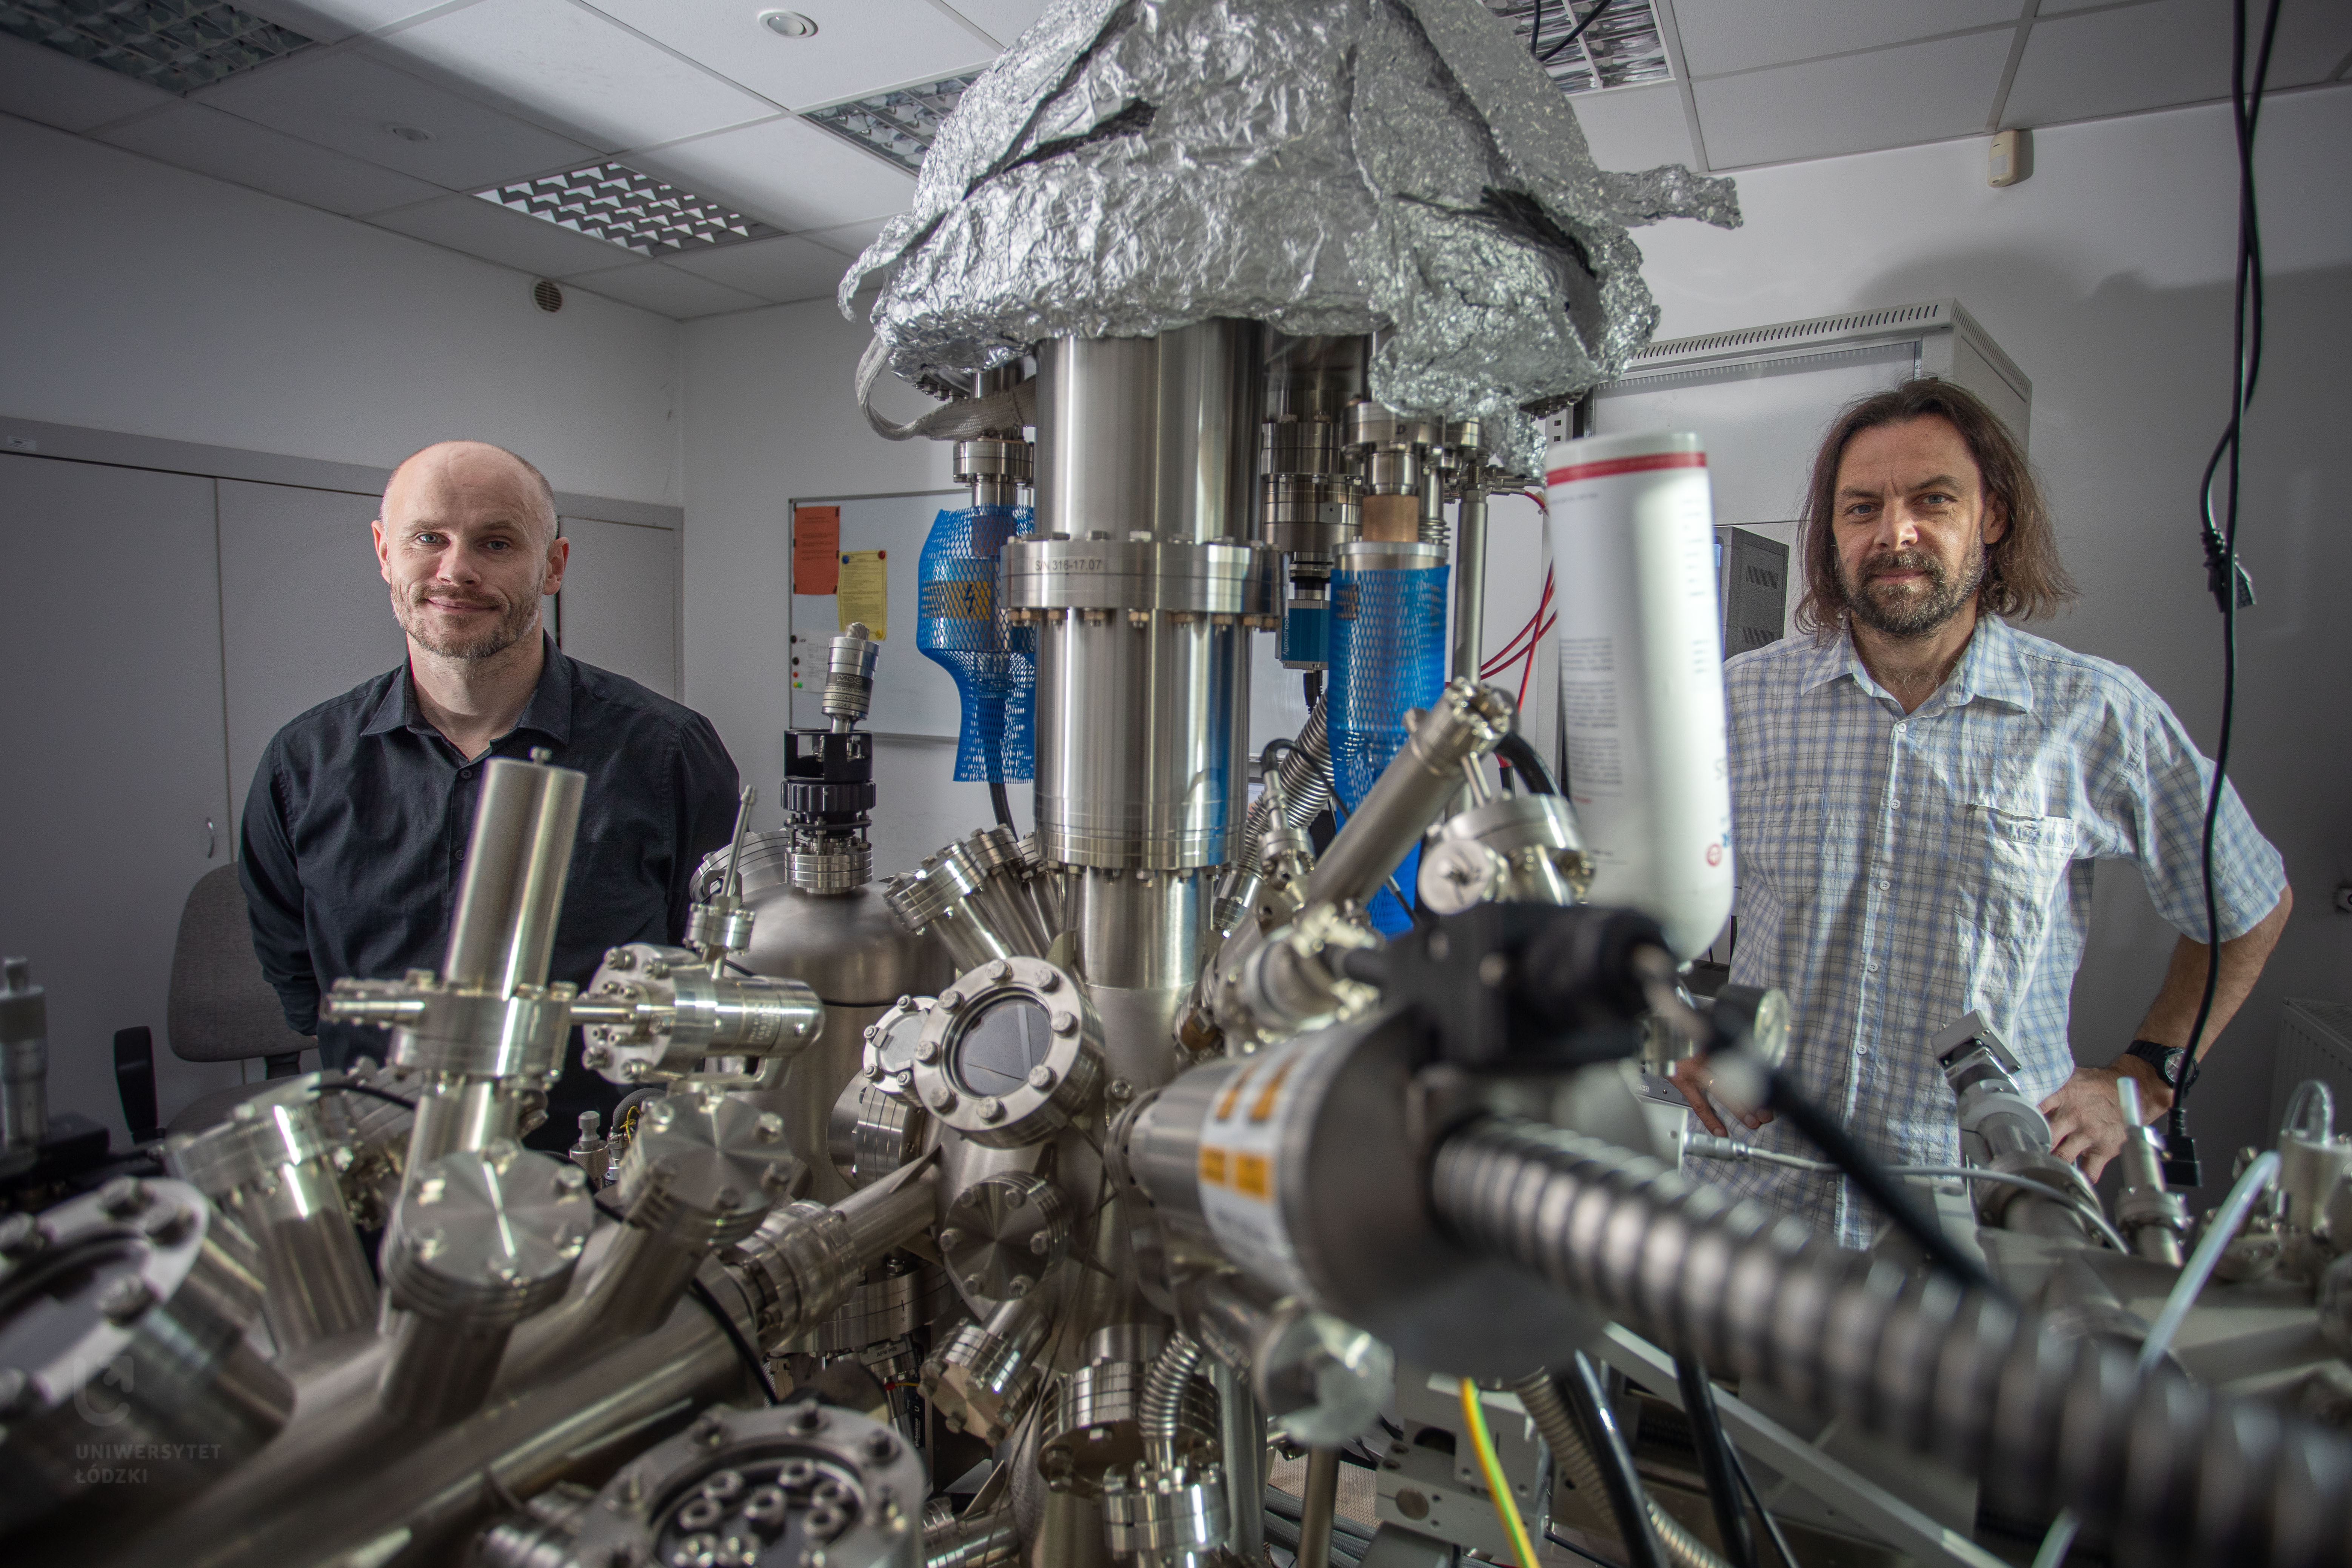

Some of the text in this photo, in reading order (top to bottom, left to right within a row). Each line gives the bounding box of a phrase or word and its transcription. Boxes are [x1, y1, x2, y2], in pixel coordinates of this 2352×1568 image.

[1395, 424, 1407, 435] D
[1035, 559, 1102, 571] S/N 316-17.07
[836, 674, 862, 685] MDC
